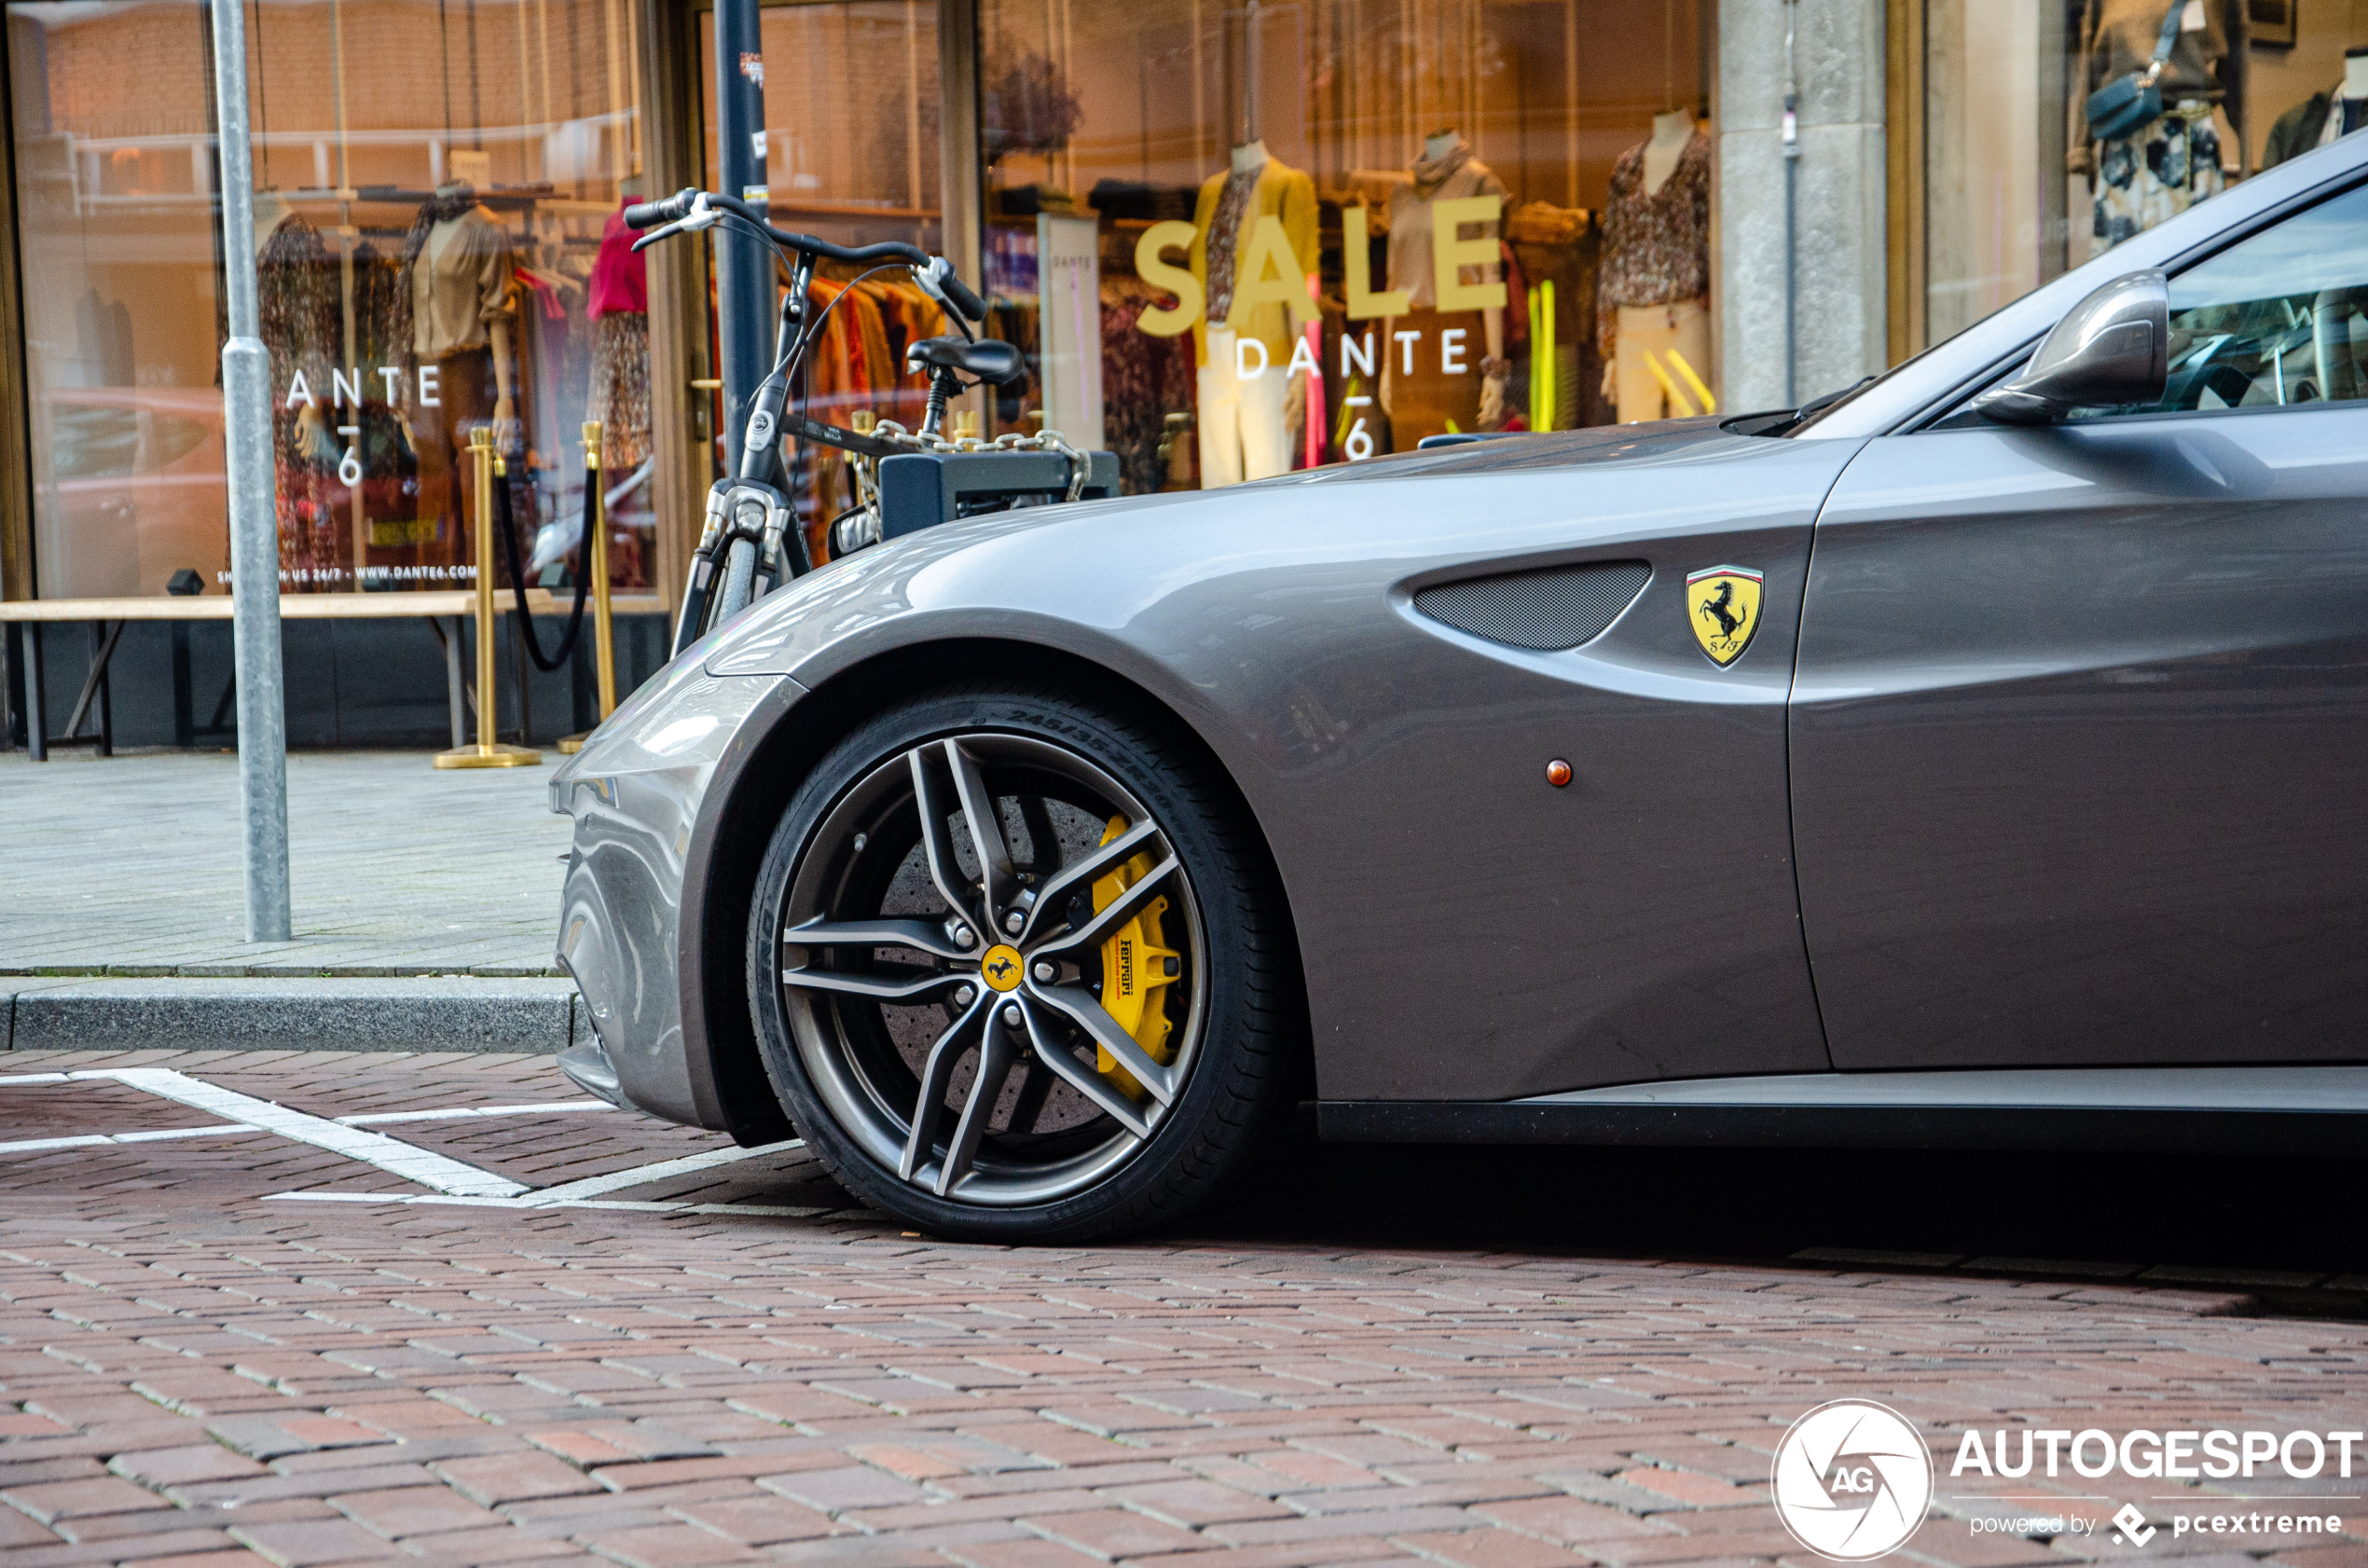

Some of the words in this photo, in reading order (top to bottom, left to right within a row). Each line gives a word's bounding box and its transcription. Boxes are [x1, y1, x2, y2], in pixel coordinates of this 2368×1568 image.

[1135, 194, 1508, 337] SALE
[1236, 328, 1467, 380] DANTE
[285, 364, 441, 409] ANTE
[1344, 417, 1374, 461] 6
[338, 446, 363, 488] 6
[292, 569, 310, 583] US
[312, 567, 341, 582] 24/7
[354, 565, 477, 580] WWW.DANTE6.COM
[1121, 940, 1134, 996] Ferrari
